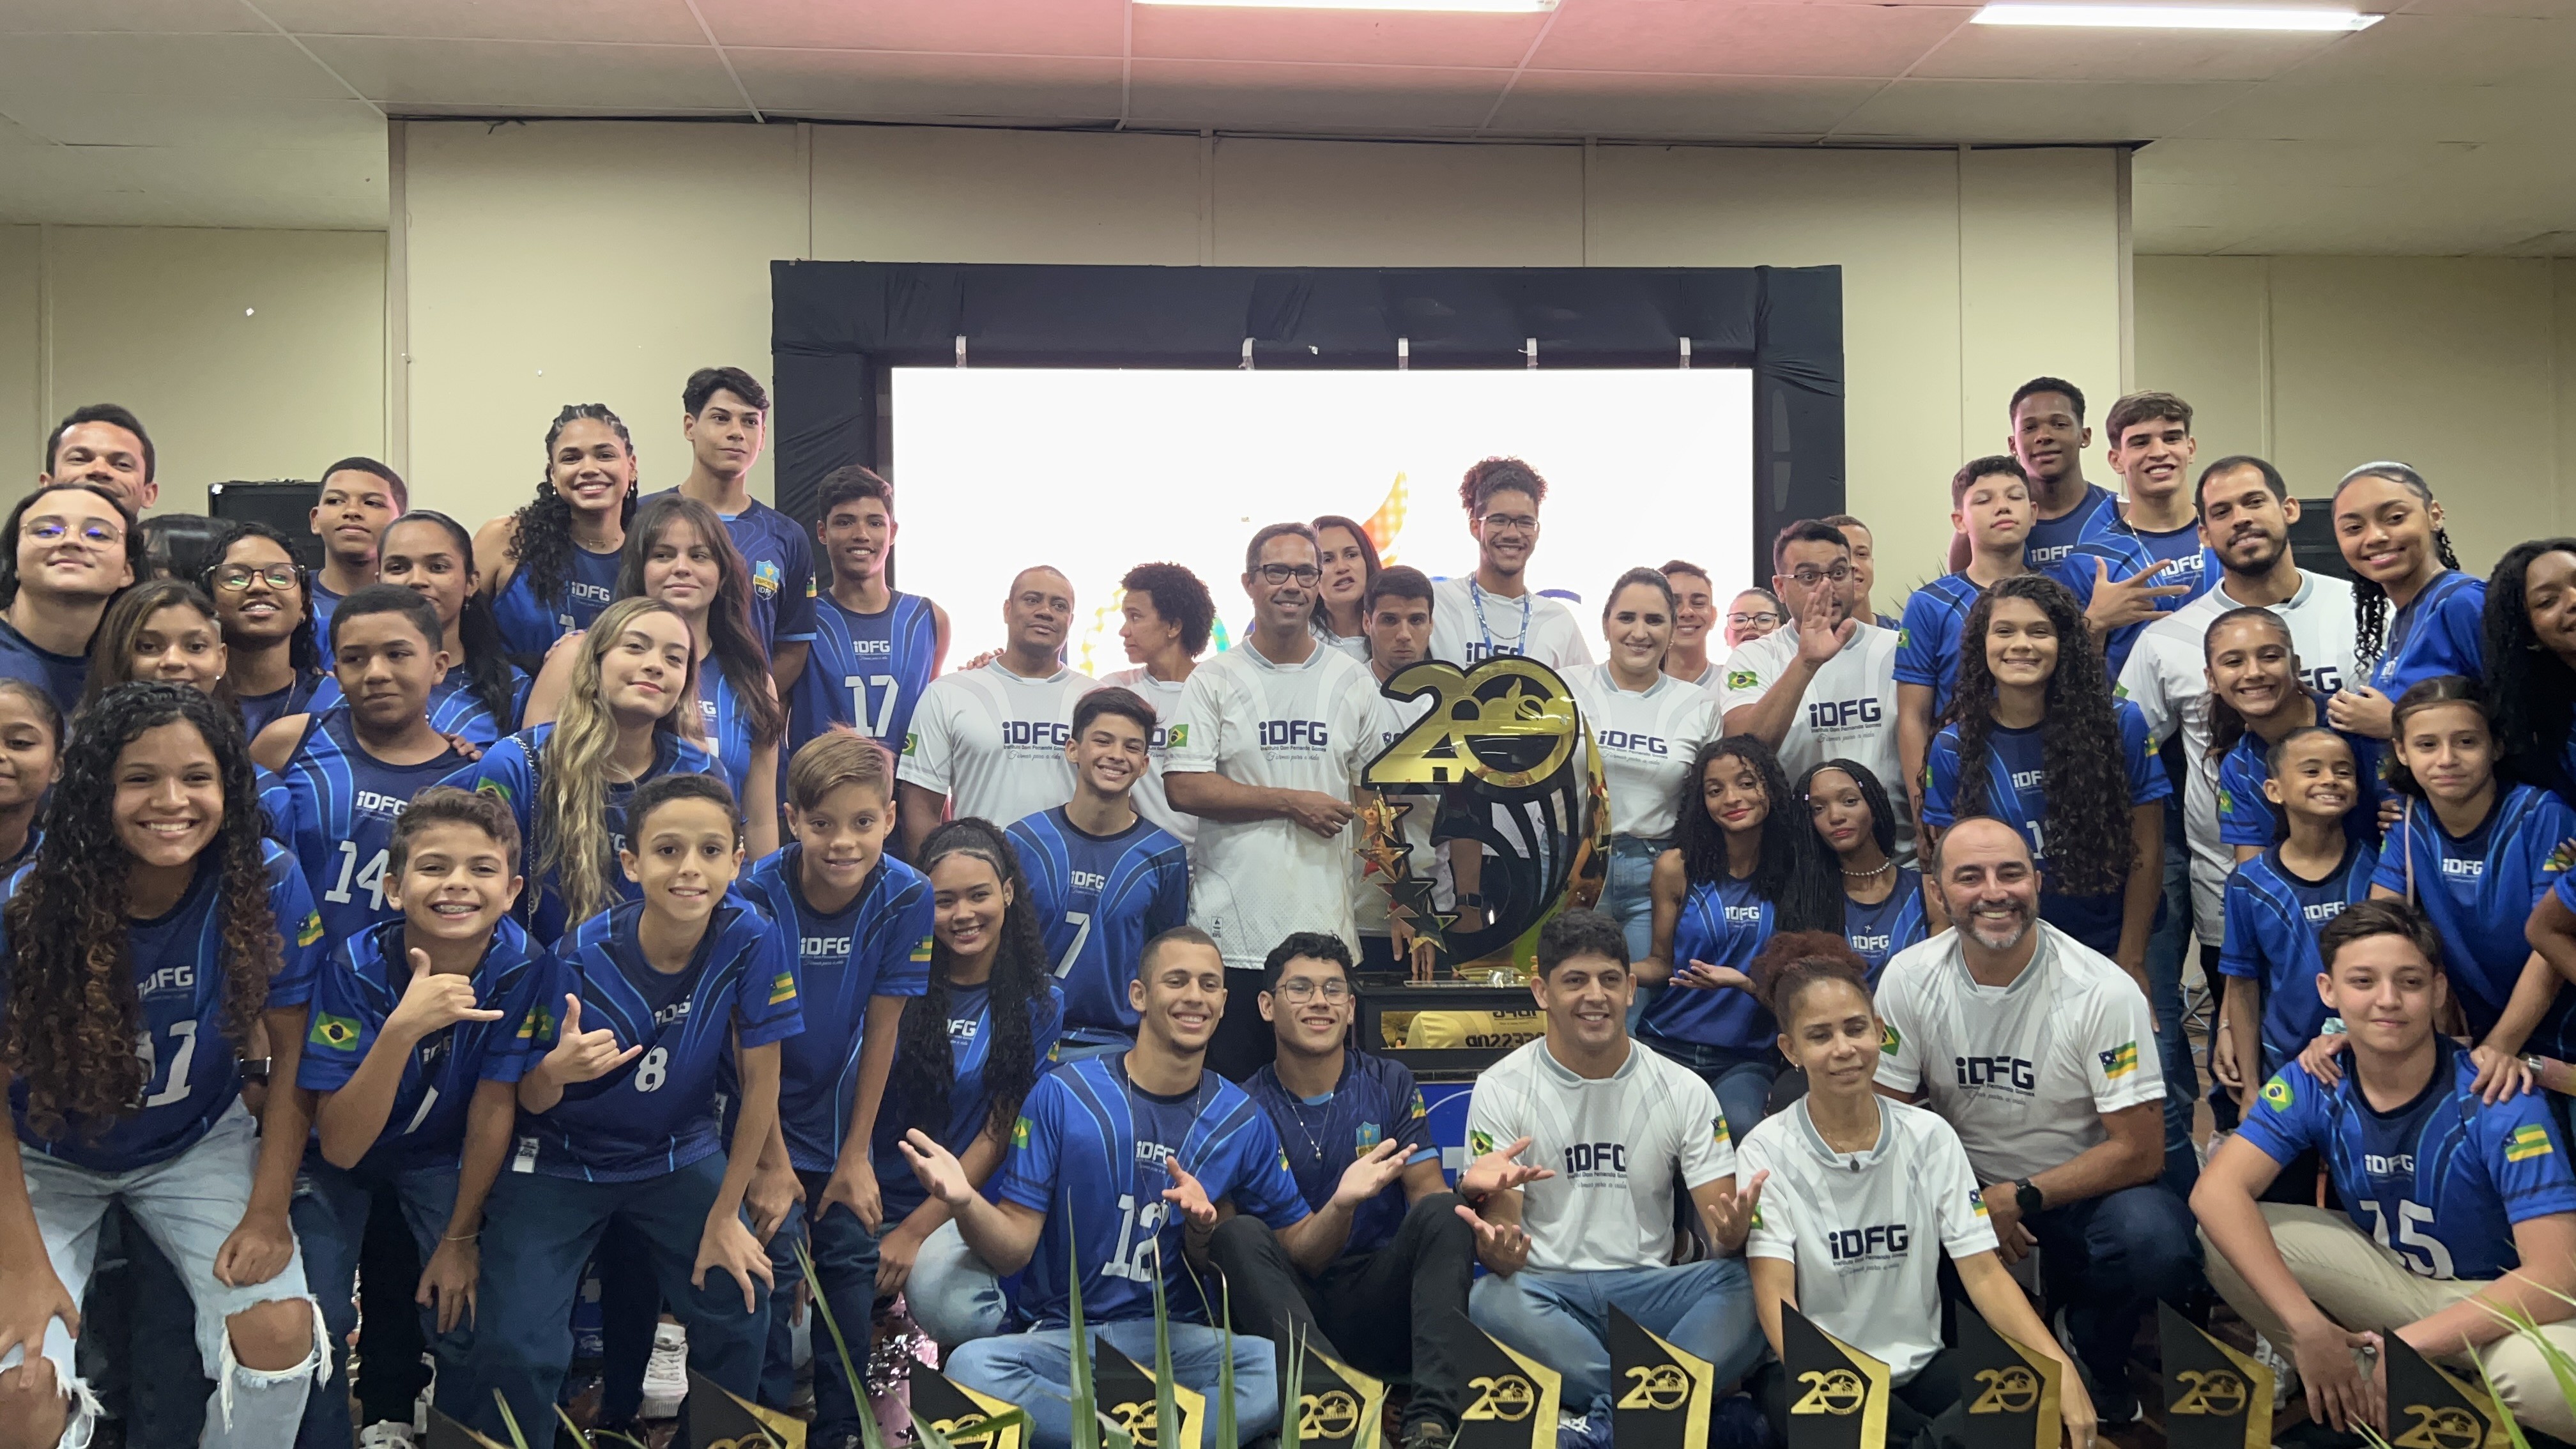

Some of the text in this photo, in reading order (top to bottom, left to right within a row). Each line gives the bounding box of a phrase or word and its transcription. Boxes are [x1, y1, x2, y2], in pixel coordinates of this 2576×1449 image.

[571, 582, 610, 601] iDFG
[853, 640, 890, 652] iDFG
[845, 675, 900, 737] 17
[1363, 656, 1577, 788] 20
[1809, 697, 1882, 727] iDFG
[1002, 721, 1071, 746] iDFG
[1258, 720, 1328, 746] iDFG
[1598, 730, 1667, 754] iDFG
[2012, 770, 2044, 788] iDF
[356, 790, 408, 815] iDFG
[325, 840, 390, 911] 14
[1071, 871, 1105, 890] iDFG
[2442, 858, 2483, 875] iDFG
[1724, 906, 1759, 921] iDFG
[800, 937, 851, 955] iDFG
[1053, 910, 1091, 979] 7
[1851, 935, 1889, 950] iDFG
[634, 1045, 668, 1092] 8
[1956, 1056, 2035, 1090] iDFG
[2365, 1154, 2414, 1174] iDFG
[1101, 1193, 1170, 1282] 12
[1828, 1224, 1908, 1259] iDFG
[2359, 1199, 2455, 1280] 15
[1461, 1374, 1535, 1421] 20
[1617, 1364, 1689, 1411] 20
[1791, 1368, 1864, 1415] 20
[1968, 1365, 2038, 1414] 20
[2170, 1368, 2246, 1417] 20
[1298, 1390, 1358, 1440] 20
[2393, 1404, 2482, 1449] 20
